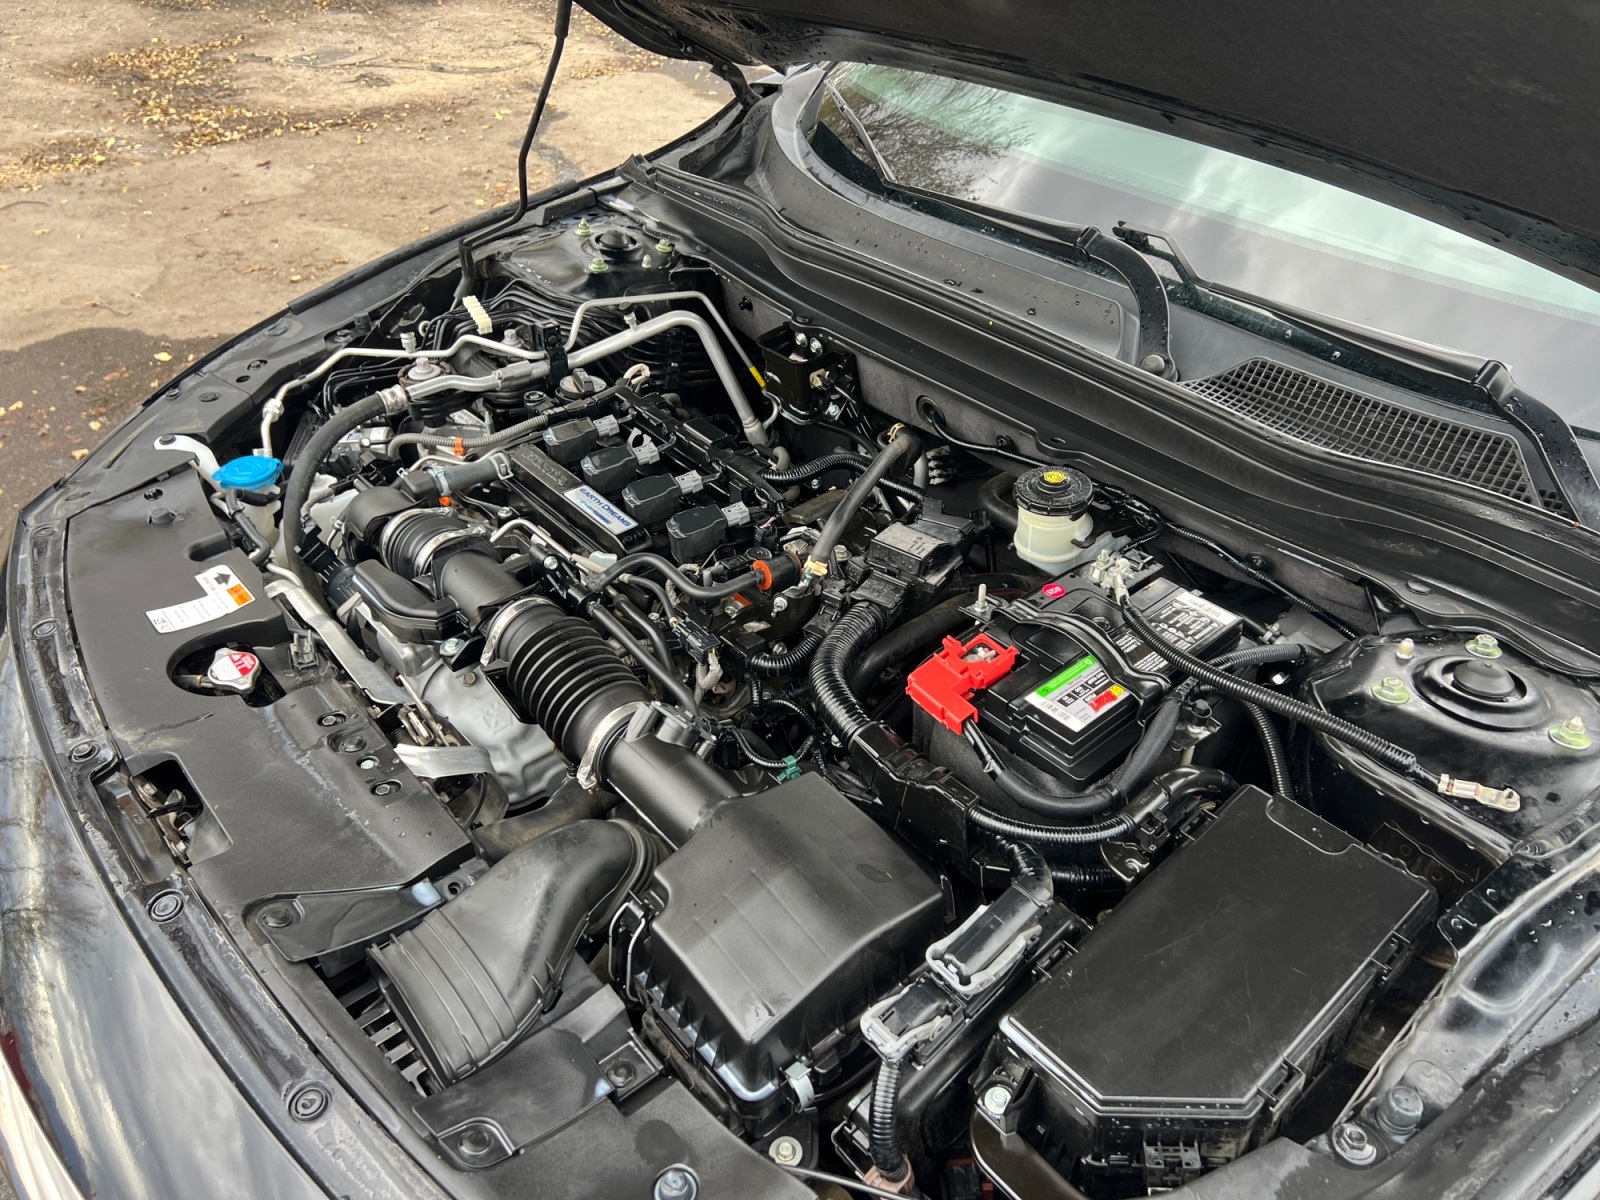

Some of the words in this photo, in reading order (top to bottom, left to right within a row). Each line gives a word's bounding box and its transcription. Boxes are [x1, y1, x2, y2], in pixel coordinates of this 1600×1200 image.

[521, 451, 567, 486] HONDA
[580, 488, 603, 505] EARTH
[602, 504, 632, 527] DREAMS
